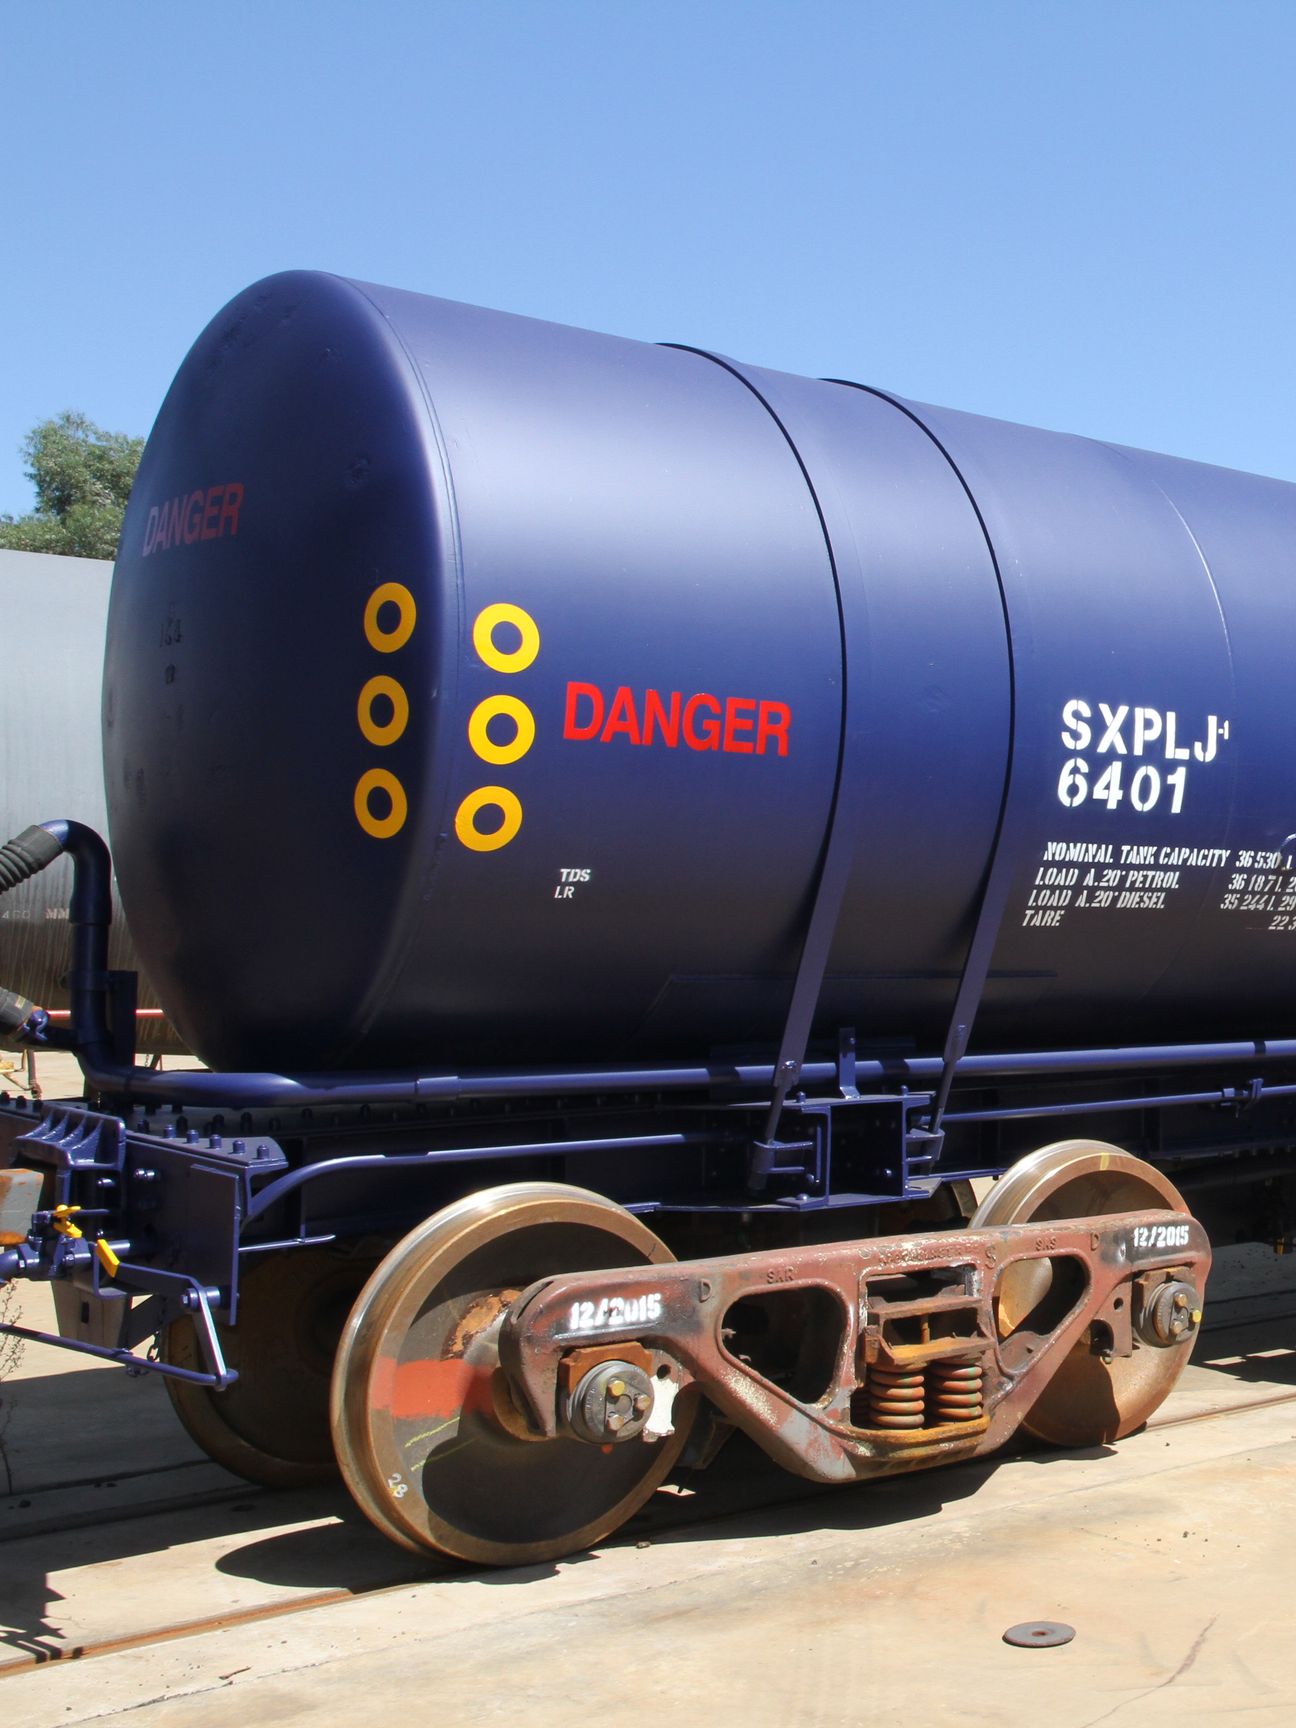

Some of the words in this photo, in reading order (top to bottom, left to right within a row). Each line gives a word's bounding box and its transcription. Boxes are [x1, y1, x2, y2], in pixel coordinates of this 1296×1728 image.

[142, 483, 245, 557] DANGER
[563, 681, 792, 757] DANGER
[1057, 757, 1186, 814] 6401
[1043, 842, 1114, 863] NOMINAL
[1120, 845, 1157, 864] TANK
[1159, 847, 1231, 867] CAPACITY
[560, 868, 591, 882] TDS
[1035, 867, 1079, 886] LOAD
[1125, 870, 1180, 889] PETROL
[554, 885, 575, 898] LR
[1027, 889, 1072, 907] LOAD
[1116, 891, 1167, 909] DIESEL
[1022, 910, 1065, 926] TARE
[1134, 1225, 1189, 1248] 12/2015
[569, 1293, 662, 1330] 12/2015
